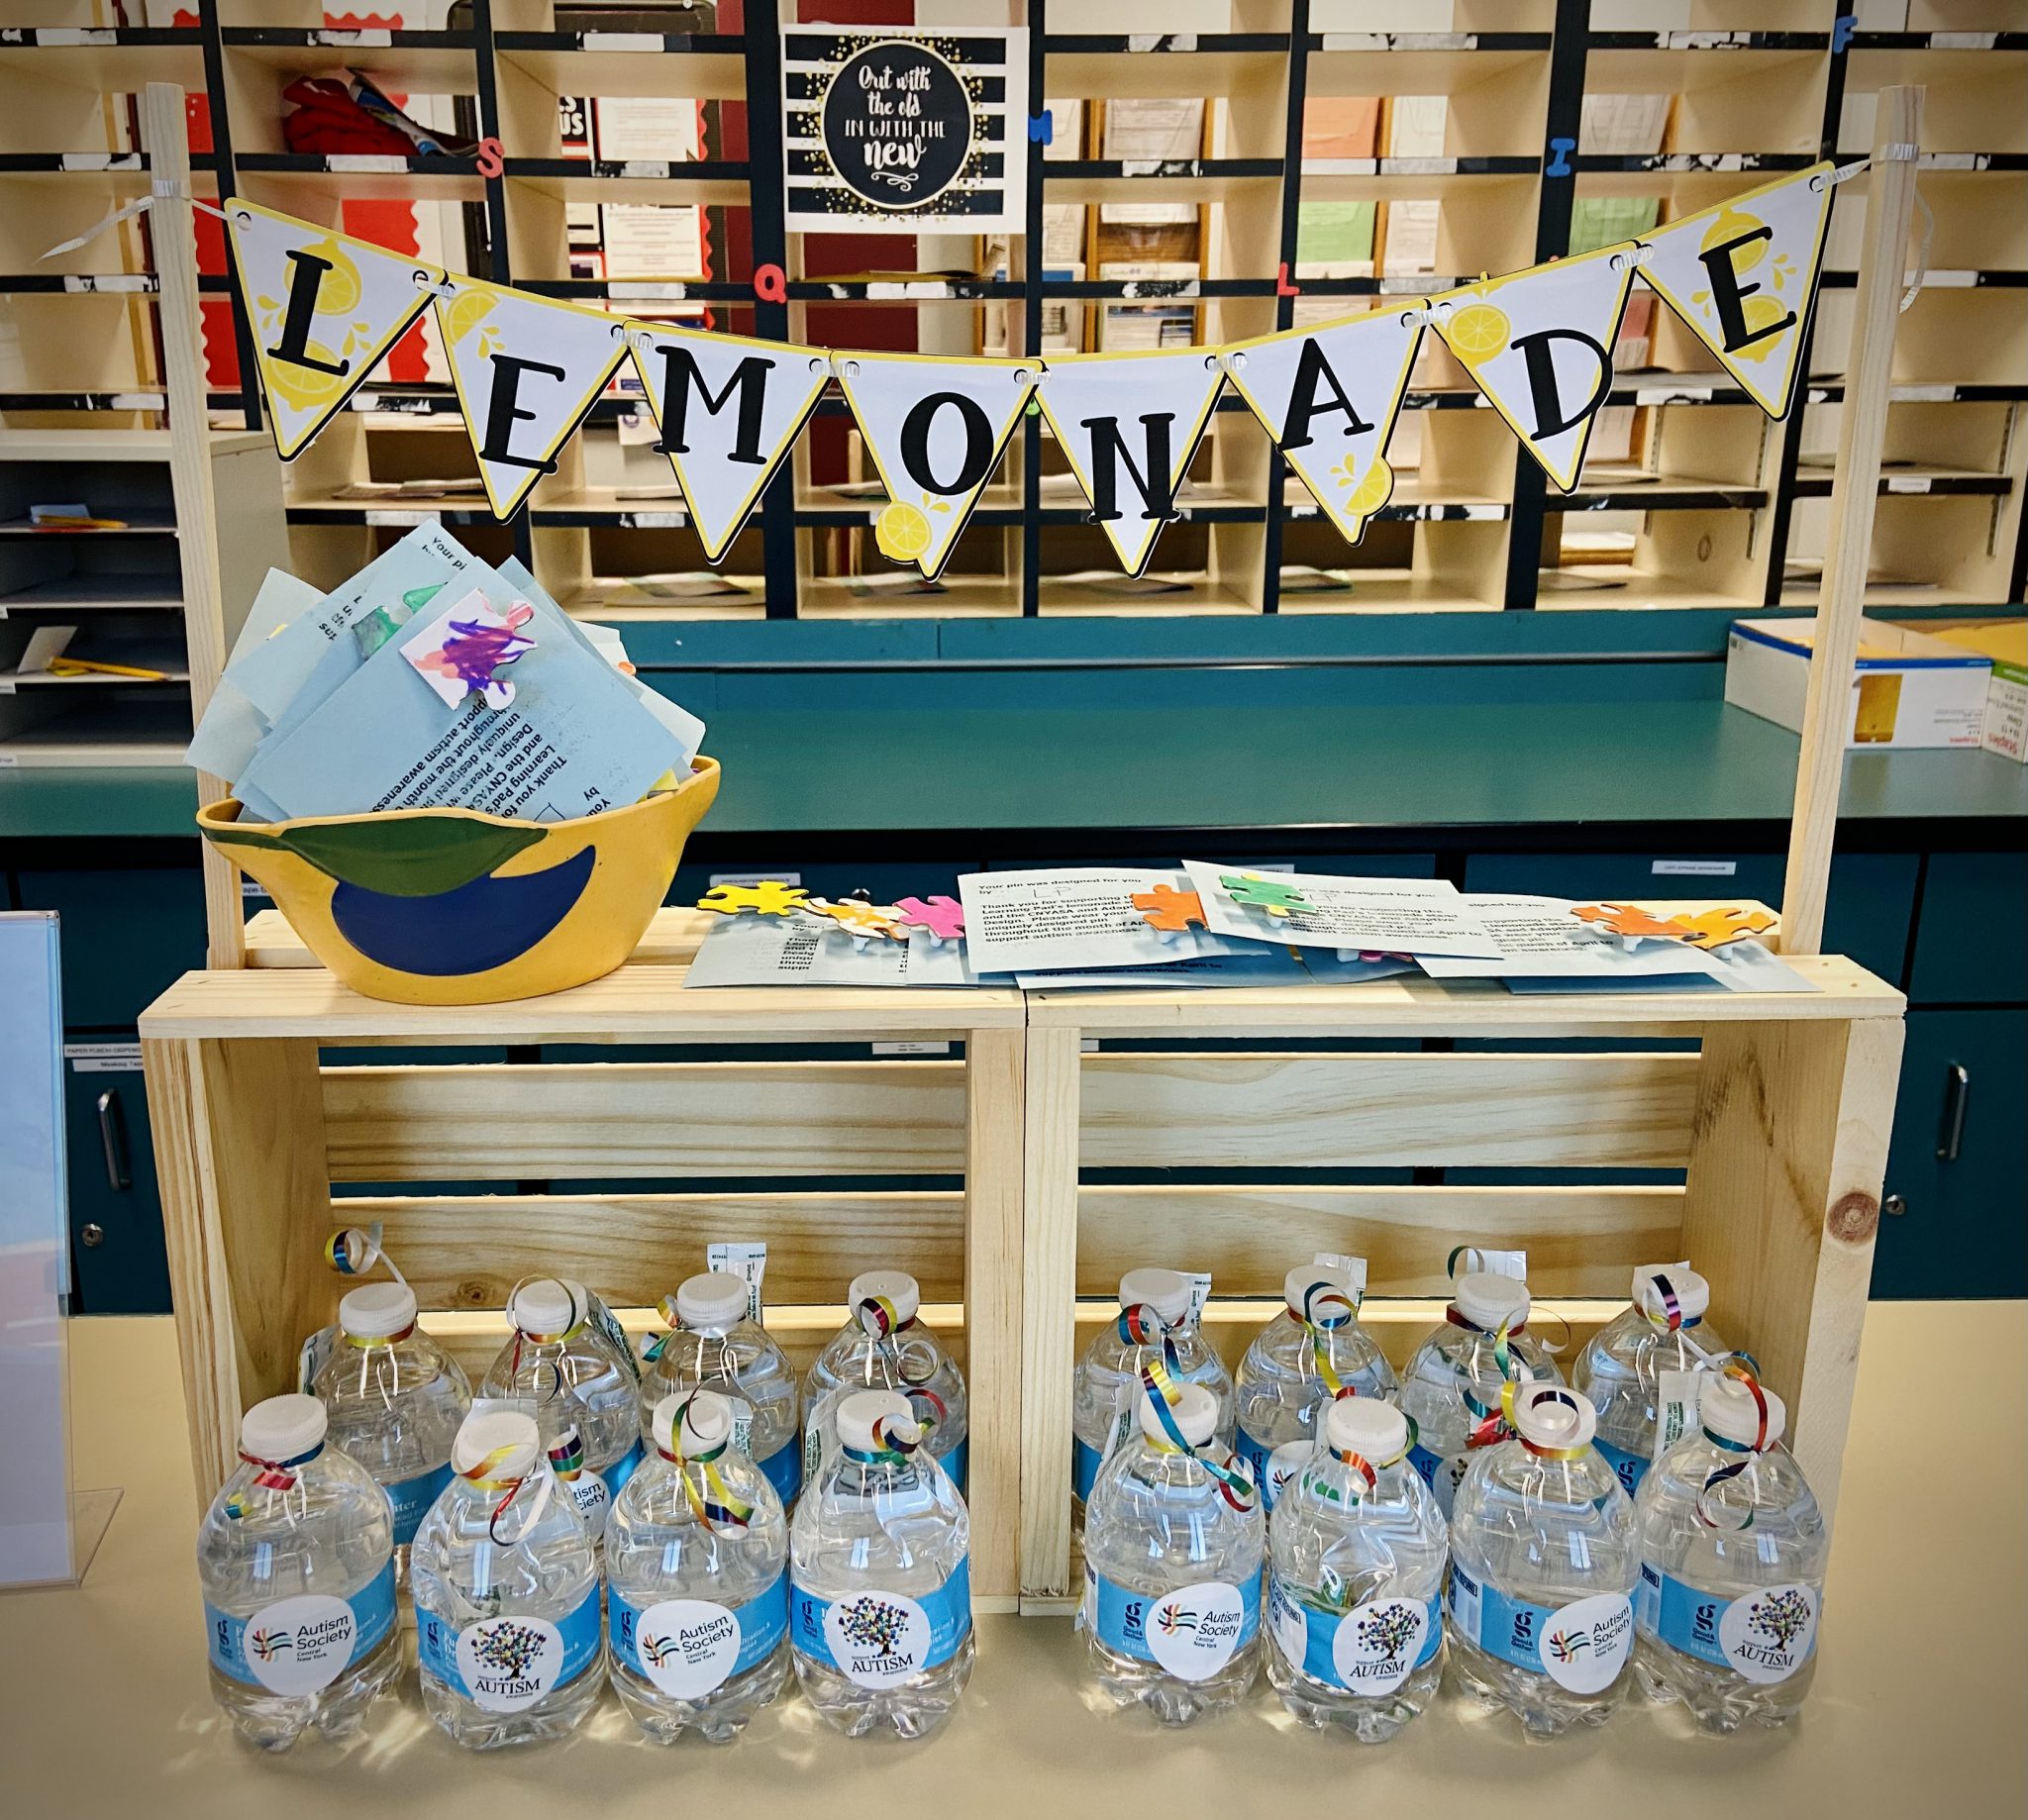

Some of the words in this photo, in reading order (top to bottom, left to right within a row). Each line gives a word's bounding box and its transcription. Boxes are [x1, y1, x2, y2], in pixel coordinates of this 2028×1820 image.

[859, 64, 893, 89] Out
[896, 65, 932, 91] with
[867, 91, 895, 116] the
[898, 91, 922, 118] old
[845, 119, 863, 137] IN
[869, 120, 913, 138] WITH
[919, 120, 947, 139] THE
[477, 137, 506, 179] S
[863, 134, 927, 170] new
[754, 263, 787, 304] Q
[1277, 262, 1300, 296] L
[431, 537, 460, 561] Your
[456, 696, 490, 731] pport
[424, 727, 460, 763] autism
[475, 710, 522, 757] uniquely
[492, 722, 533, 761] Design.
[521, 733, 544, 756] and
[434, 754, 456, 776] the
[504, 752, 525, 773] the
[508, 743, 555, 789] Learning
[533, 755, 566, 788] Thank
[432, 753, 480, 800] designed
[458, 761, 494, 797] Please
[402, 771, 439, 809] month
[483, 785, 514, 816] Pad's
[511, 781, 535, 805] you
[581, 784, 599, 802] by
[985, 927, 1050, 937] throughout
[573, 1482, 601, 1500] tism
[578, 1489, 605, 1511] ciety
[297, 1615, 349, 1638] Autism
[679, 1616, 729, 1641] Autism
[1203, 1611, 1240, 1623] Autism
[1593, 1605, 1630, 1634] Autism
[297, 1626, 352, 1650] Society
[682, 1625, 734, 1653] Society
[1198, 1623, 1239, 1637] Society
[1593, 1618, 1630, 1647] Society
[685, 1649, 708, 1660] Central
[852, 1653, 914, 1672] AUTISM
[1733, 1644, 1794, 1668] AUTISM
[1350, 1660, 1406, 1678] AUTISM
[475, 1677, 541, 1695] AUTISM
